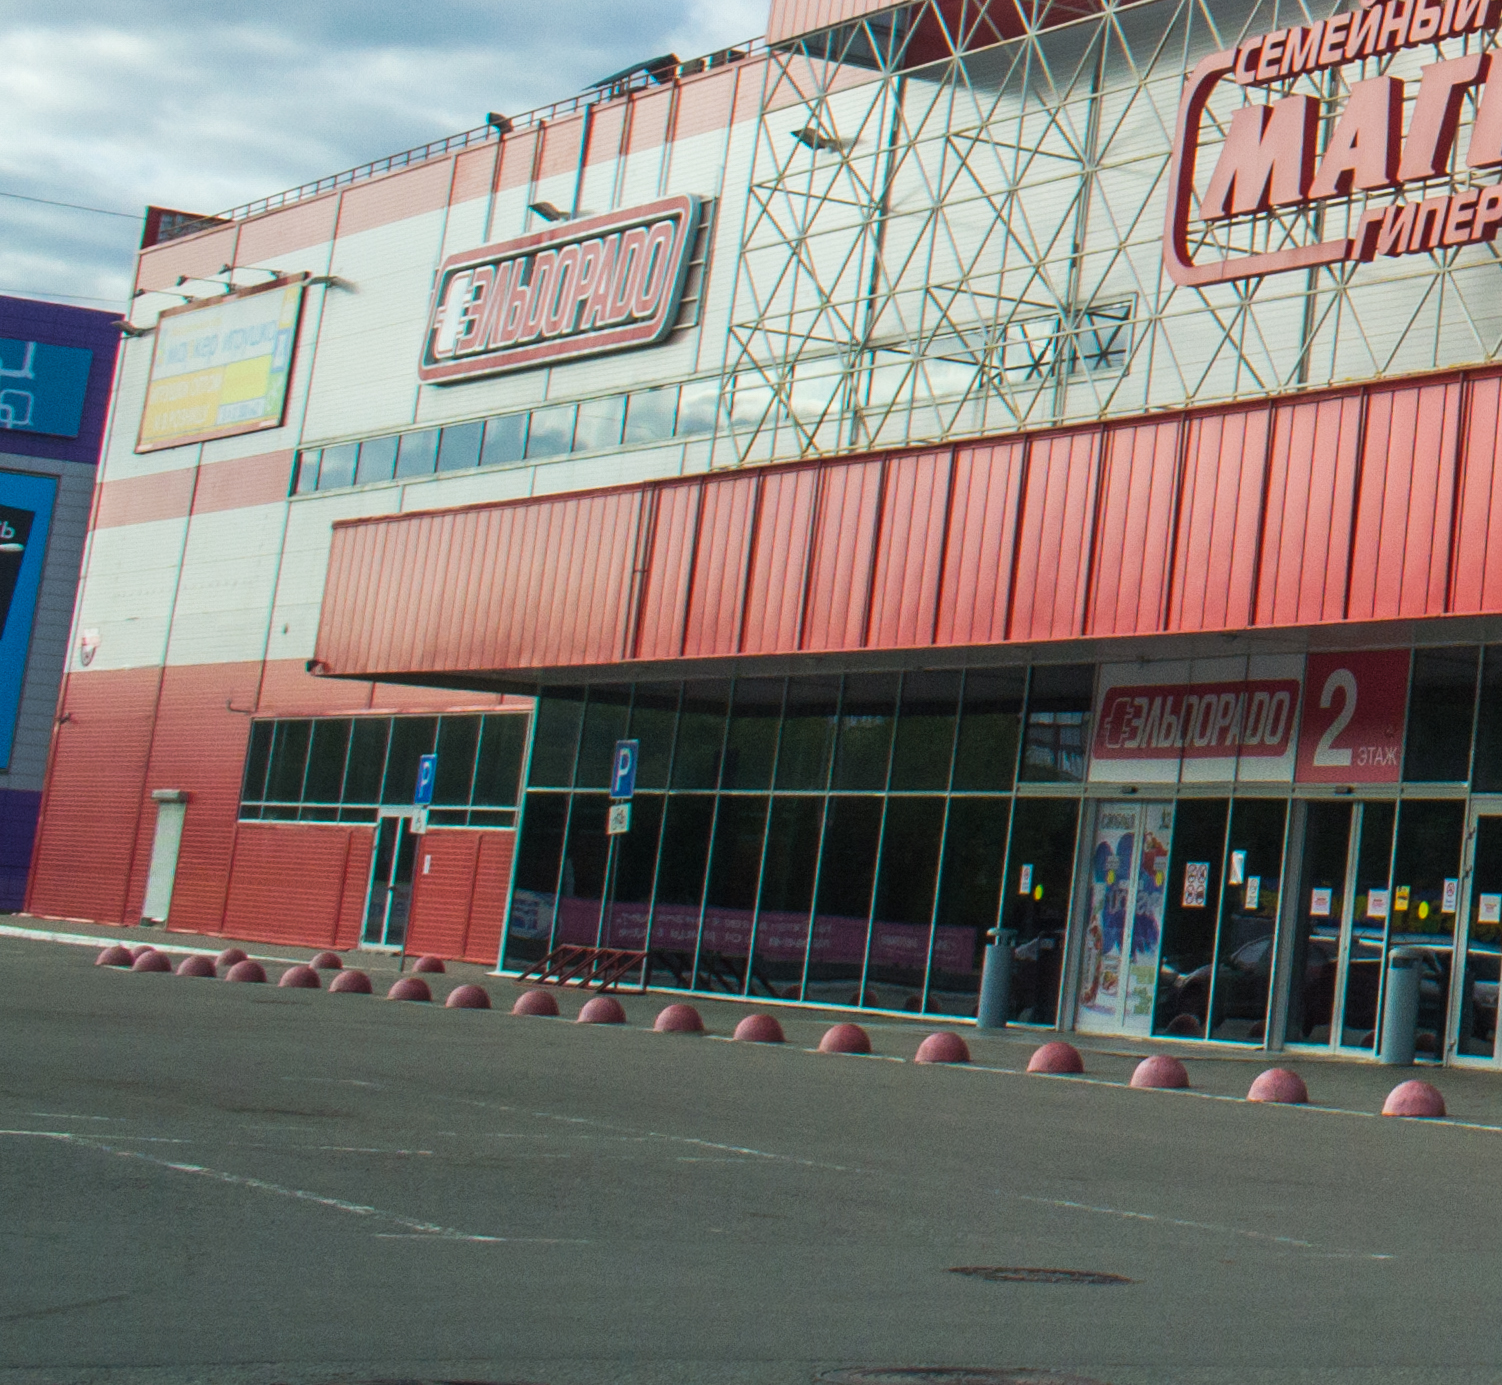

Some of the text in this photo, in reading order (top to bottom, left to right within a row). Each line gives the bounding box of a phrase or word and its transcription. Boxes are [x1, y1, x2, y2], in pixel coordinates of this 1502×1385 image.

[1313, 668, 1397, 766] 2 ЭТАЖ
[417, 761, 434, 798] P
[614, 747, 632, 793] P
